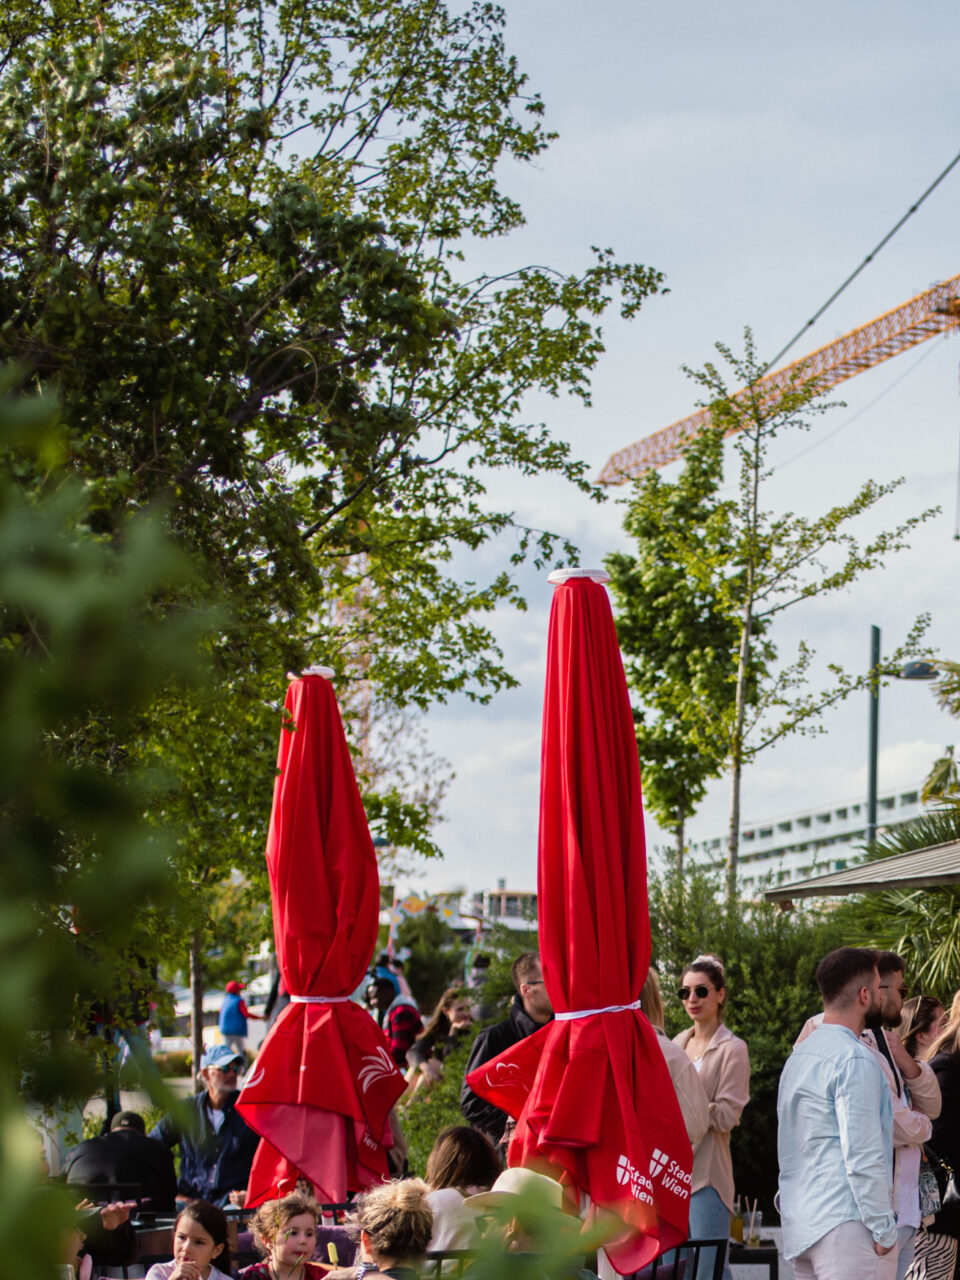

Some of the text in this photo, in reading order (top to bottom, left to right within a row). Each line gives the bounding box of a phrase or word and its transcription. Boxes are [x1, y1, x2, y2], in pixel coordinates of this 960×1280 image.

[363, 1131, 378, 1151] ien
[630, 1165, 654, 1194] Stad
[661, 1172, 689, 1200] Wien
[667, 1160, 693, 1187] Stad
